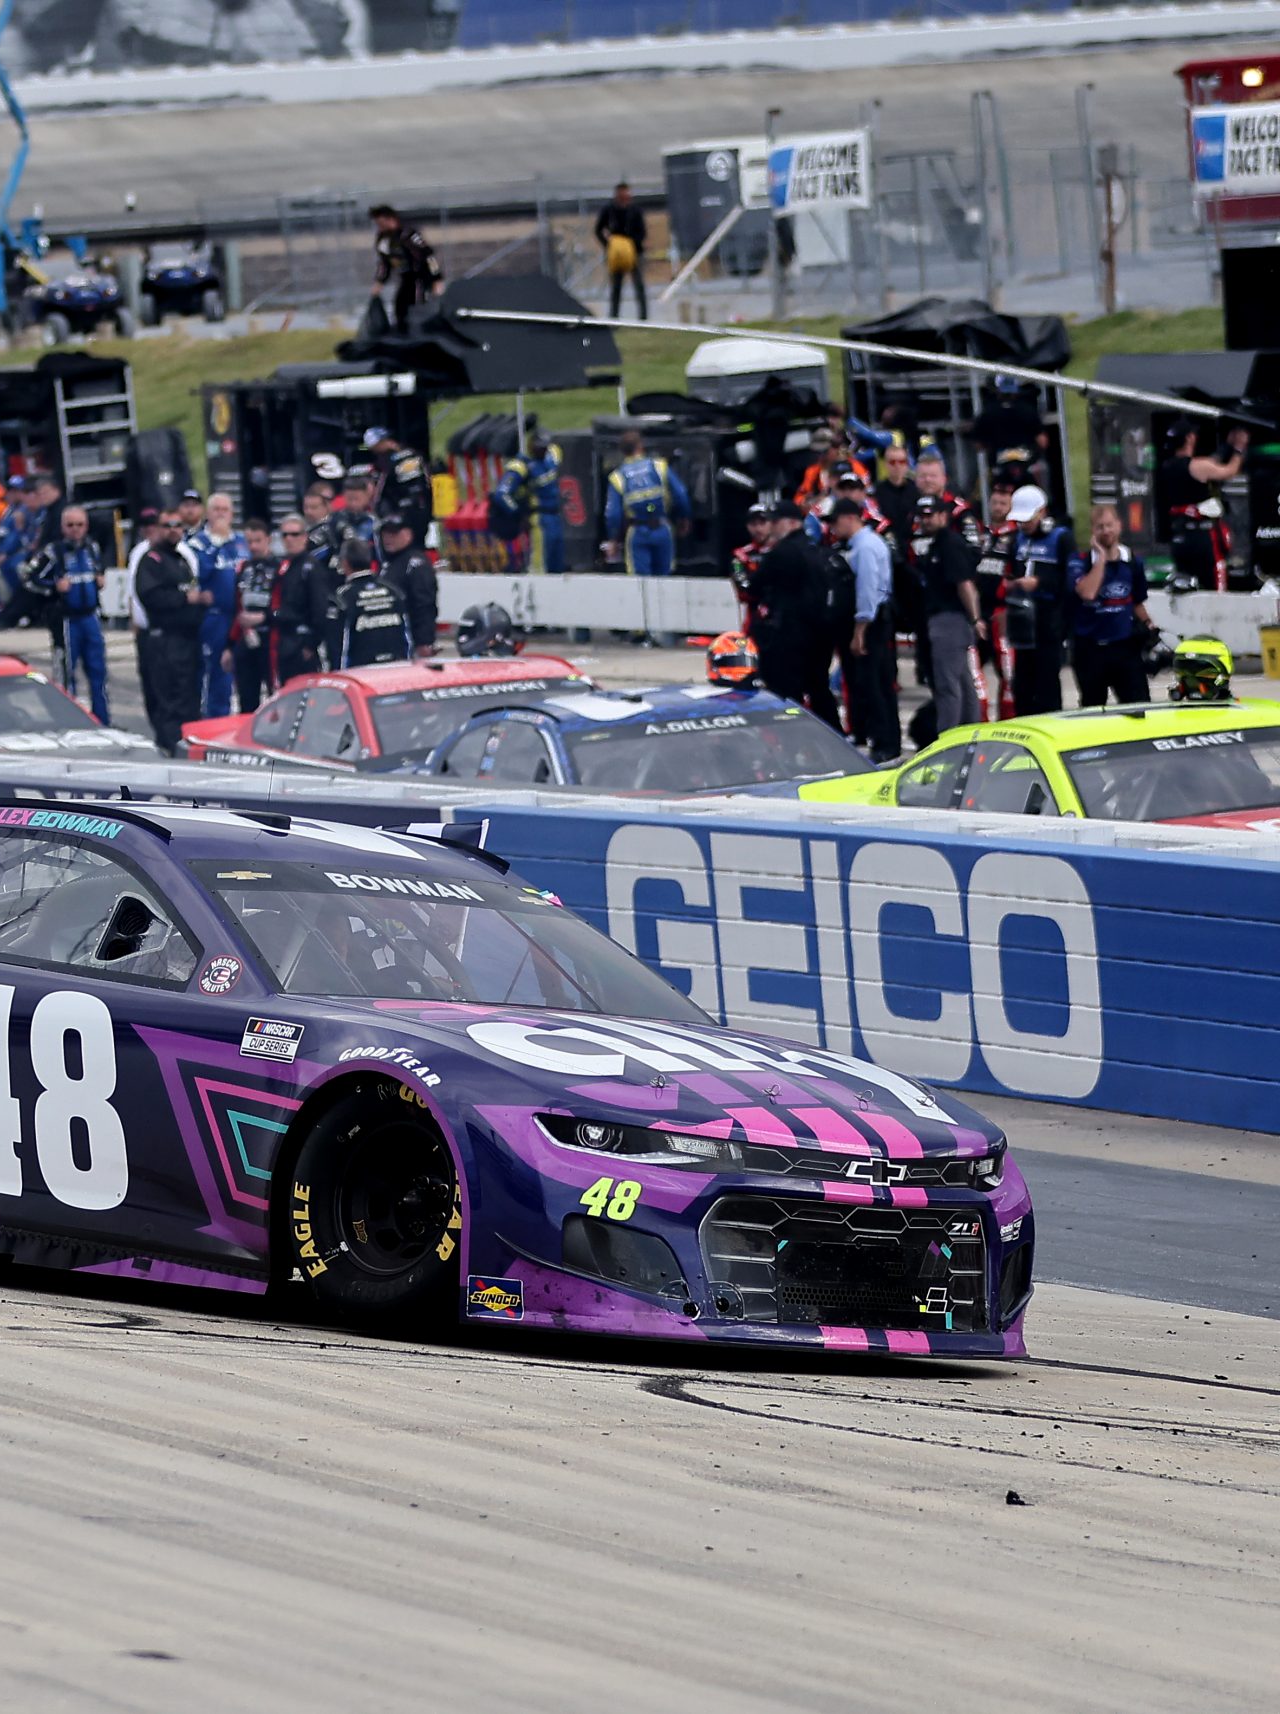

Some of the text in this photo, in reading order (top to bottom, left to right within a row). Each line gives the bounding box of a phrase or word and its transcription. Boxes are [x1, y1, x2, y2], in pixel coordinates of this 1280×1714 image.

[797, 143, 859, 170] WELCOME
[311, 453, 345, 480] 3
[422, 680, 548, 702] KESELOWSKI
[644, 714, 748, 736] A.DILLON
[1152, 731, 1246, 752] BLANEY
[323, 871, 486, 902] BOWMAN
[210, 957, 240, 973] NASCAR
[605, 824, 1104, 1098] GEICO
[201, 977, 231, 993] SALUTES
[263, 1022, 296, 1038] NASCAR
[249, 1037, 291, 1054] CUP SERIES
[338, 1046, 441, 1088] GOODYEAR
[464, 1012, 959, 1124] ally
[579, 1176, 643, 1222] 48
[293, 1181, 329, 1278] EAGLE
[947, 1222, 980, 1236] ZL1
[471, 1291, 519, 1306] SUNOCO
